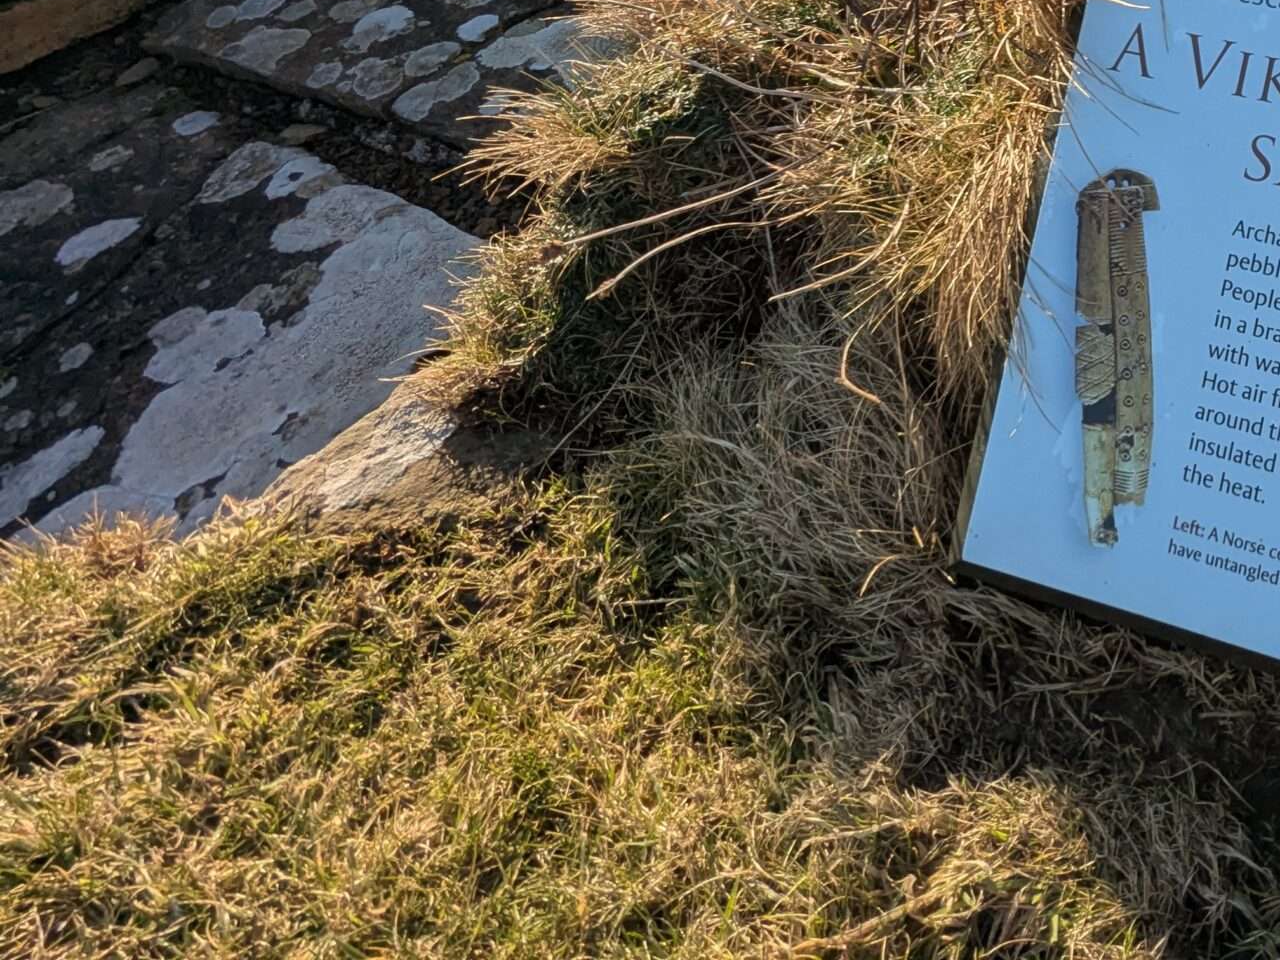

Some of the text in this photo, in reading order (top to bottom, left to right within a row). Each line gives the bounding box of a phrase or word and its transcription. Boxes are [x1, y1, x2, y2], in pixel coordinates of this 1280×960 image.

[1106, 22, 1155, 80] A
[1214, 309, 1232, 331] in
[1236, 319, 1248, 335] a
[1209, 344, 1250, 368] with
[1201, 370, 1239, 398] Hot
[1241, 385, 1269, 404] air
[1194, 406, 1265, 437] around
[1188, 433, 1278, 473] insulated
[1183, 463, 1265, 505] the heat.
[1173, 515, 1206, 539] Left:
[1207, 527, 1219, 543] A
[1222, 530, 1266, 556] Norse
[1168, 538, 1203, 563] have
[1205, 553, 1280, 586] untangled
